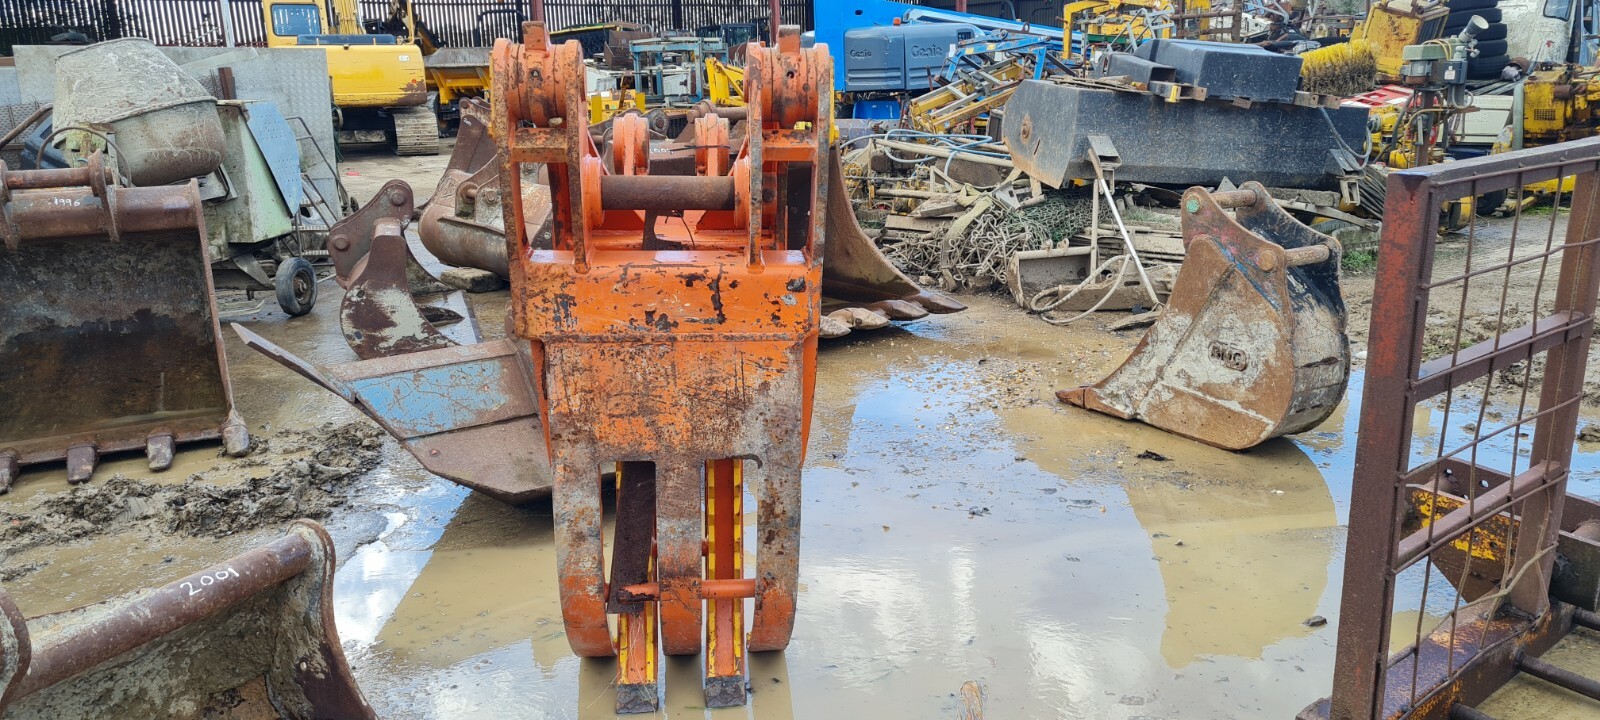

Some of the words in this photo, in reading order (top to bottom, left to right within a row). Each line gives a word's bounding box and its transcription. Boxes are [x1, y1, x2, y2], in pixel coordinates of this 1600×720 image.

[850, 49, 872, 58] Genie
[911, 44, 943, 58] Genie
[54, 196, 81, 207] 1996
[180, 568, 239, 595] 2001
